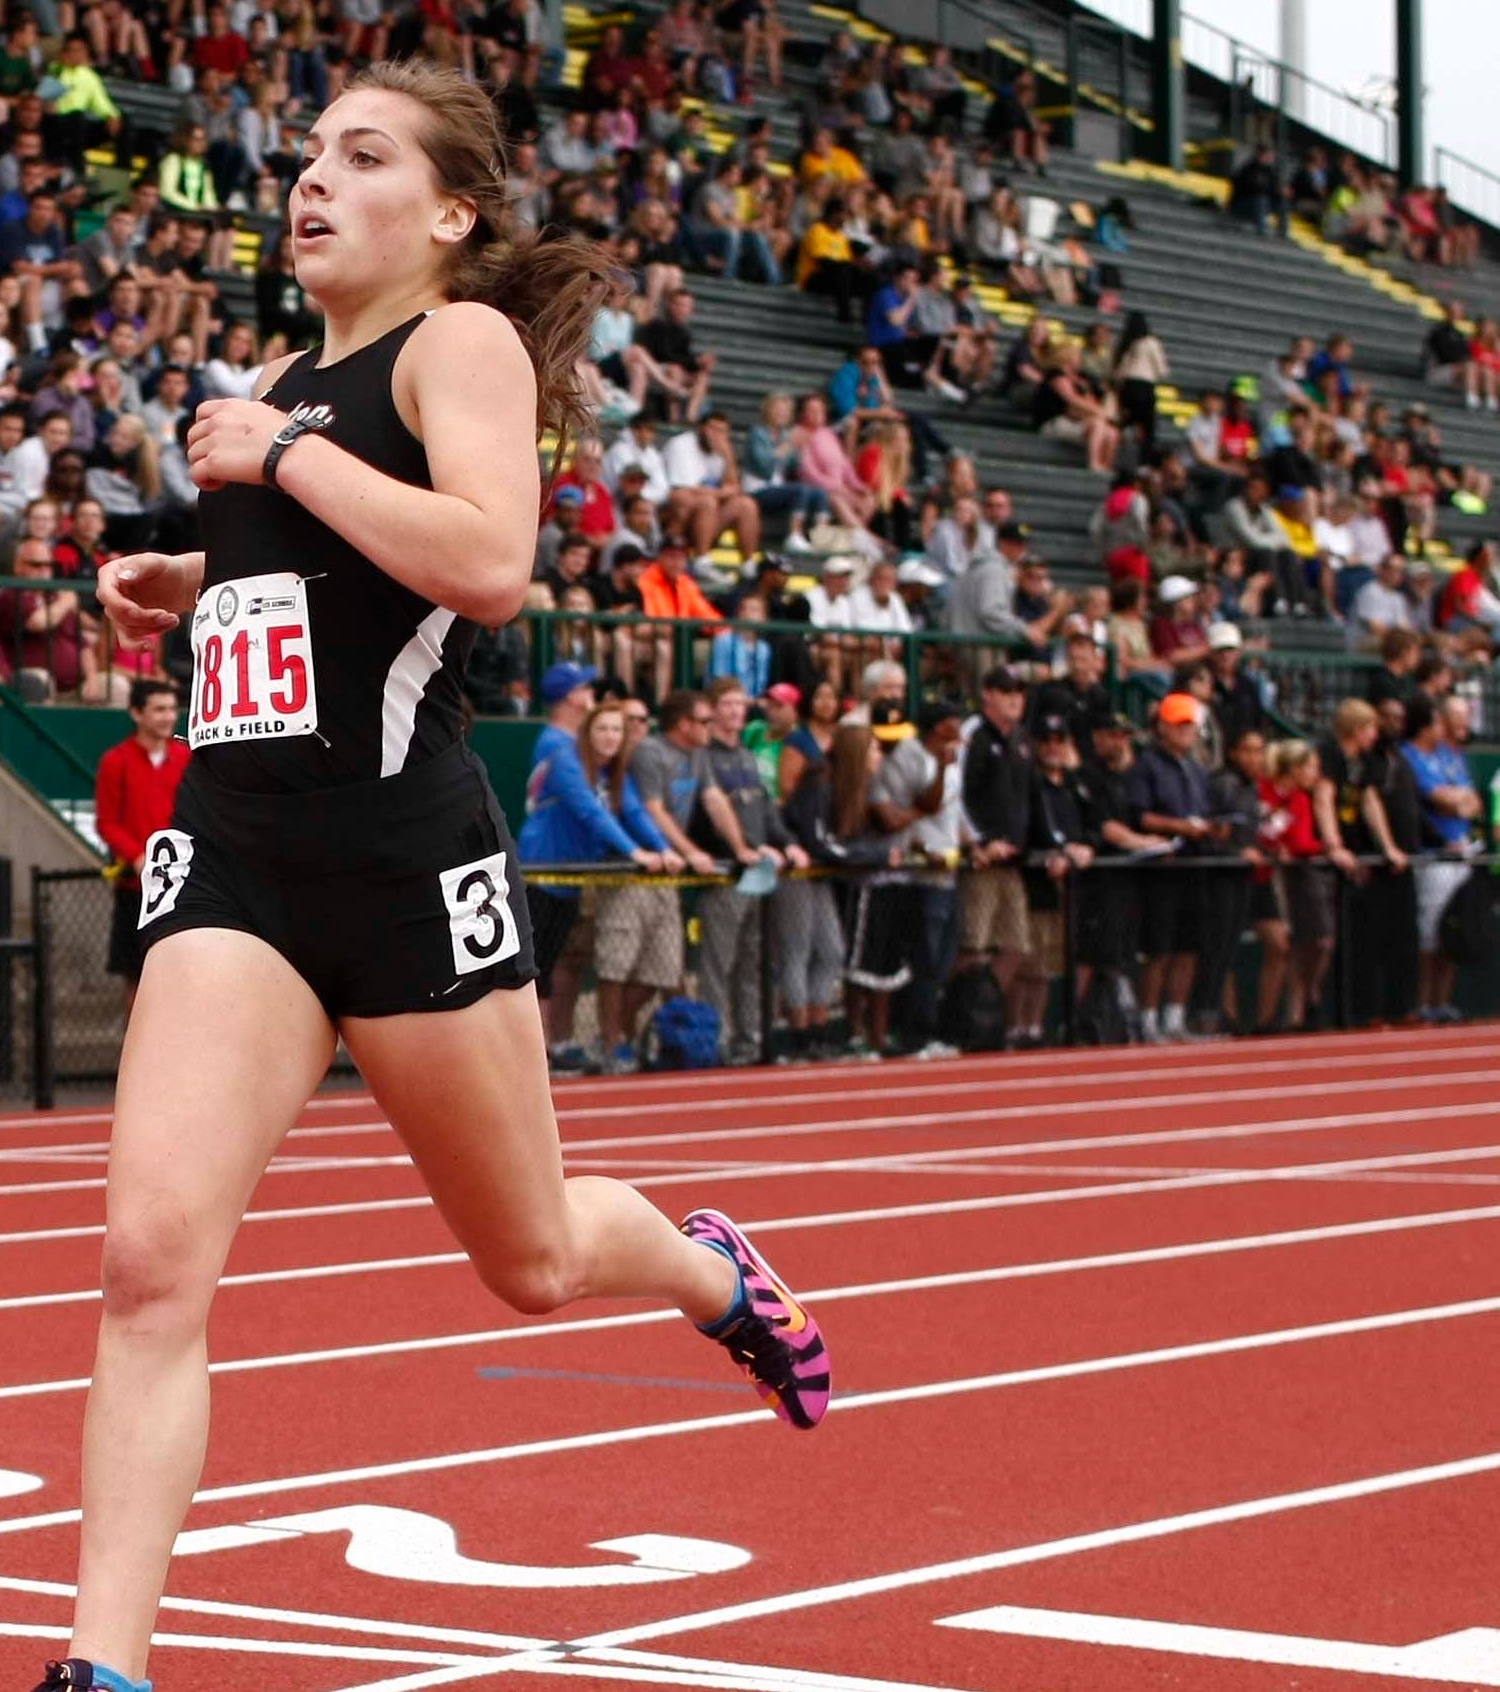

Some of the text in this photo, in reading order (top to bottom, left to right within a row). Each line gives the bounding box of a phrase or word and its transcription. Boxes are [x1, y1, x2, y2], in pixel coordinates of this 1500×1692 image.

[240, 720, 285, 736] FIELD
[147, 836, 178, 914] 3
[456, 870, 504, 959] 3
[171, 1504, 752, 1587] 2
